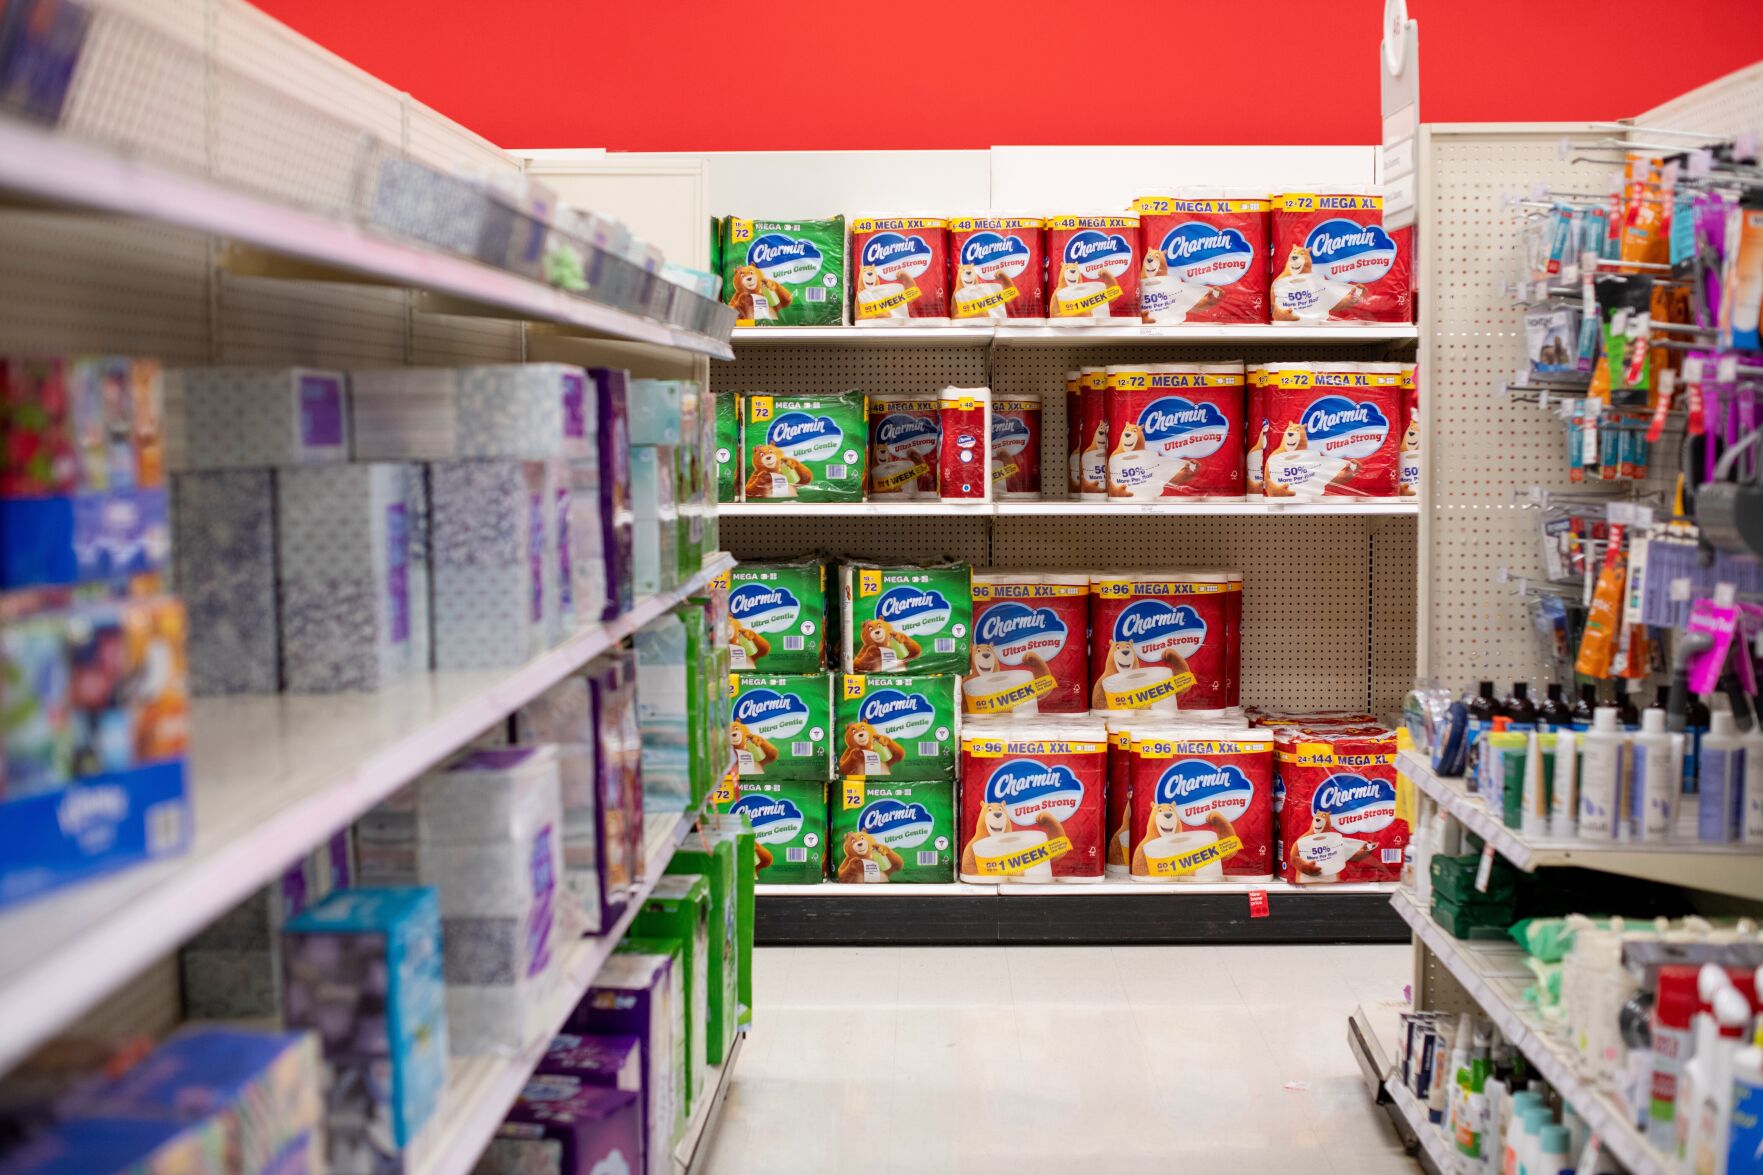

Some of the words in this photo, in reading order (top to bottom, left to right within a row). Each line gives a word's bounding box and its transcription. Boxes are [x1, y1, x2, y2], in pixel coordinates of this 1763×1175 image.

[1153, 201, 1169, 211] 72
[1175, 202, 1213, 213] MEGA
[1217, 202, 1233, 212] XL
[1298, 198, 1313, 208] 72
[1319, 198, 1357, 208] MEGA
[1361, 199, 1376, 208] XL
[755, 223, 782, 231] MEGA
[859, 222, 872, 230] 48
[875, 220, 904, 230] MEGA
[907, 220, 925, 228] XXL
[958, 221, 971, 229] 48
[974, 220, 1002, 229] MEGA
[1005, 219, 1023, 228] XXL
[1061, 219, 1075, 228] 48
[1078, 219, 1106, 228] MEGA
[1109, 219, 1127, 227] XXL
[736, 230, 749, 238] 72
[1312, 227, 1376, 257] Charmin
[752, 240, 806, 263] Charmin
[867, 238, 915, 262] Charmin
[966, 237, 1014, 261] Charmin
[1070, 236, 1118, 260] Charmin
[1167, 231, 1232, 260] Charmin
[773, 269, 792, 279] Ultra
[793, 264, 817, 273] Gentle
[882, 265, 901, 275] Ultra
[902, 259, 928, 268] Strong
[981, 264, 1000, 274] Ultra
[1000, 258, 1025, 268] Strong
[1085, 263, 1104, 273] Ultra
[1104, 257, 1129, 267] Strong
[1186, 266, 1212, 278] Ultra
[1212, 260, 1247, 271] Strong
[1331, 263, 1355, 275] Ultra
[1355, 257, 1390, 269] Strong
[879, 294, 906, 310] WEEK
[976, 293, 1004, 309] WEEK
[1080, 292, 1108, 309] WEEK
[1144, 292, 1168, 304] 50%
[1288, 290, 1312, 302] 50%
[1130, 376, 1144, 386] 72
[1151, 376, 1188, 386] MEGA
[1193, 376, 1207, 386] XL
[1294, 375, 1308, 385] 72
[1315, 376, 1350, 386] MEGA
[1355, 376, 1369, 385] XL
[755, 409, 769, 417] 72
[888, 401, 913, 410] MEGA
[916, 400, 933, 409] XXL
[1144, 404, 1207, 434] Charmin
[1307, 404, 1368, 433] Charmin
[773, 418, 826, 442] Charmin
[880, 418, 925, 442] Charmin
[793, 447, 812, 456] Ultra
[814, 442, 837, 451] Gentle
[894, 442, 912, 453] Ultra
[912, 438, 935, 448] Strong
[1002, 440, 1025, 448] Strong
[1164, 439, 1188, 451] Ultra
[1189, 433, 1222, 446] Strong
[1326, 440, 1349, 451] Ultra
[1351, 434, 1382, 445] Strong
[892, 470, 916, 484] WEEK
[1121, 466, 1145, 480] 50%
[1284, 466, 1307, 477] 50%
[713, 580, 726, 589] 72
[864, 583, 878, 591] 72
[973, 586, 989, 597] 96
[994, 586, 1029, 597] MEGA
[1034, 586, 1056, 596] XXL
[1112, 583, 1129, 594] 96
[1134, 584, 1170, 595] MEGA
[1174, 584, 1196, 594] XXL
[730, 590, 782, 614] Charmin
[881, 592, 933, 617] Charmin
[750, 619, 769, 629] Ultra
[771, 613, 794, 622] Gentle
[902, 622, 921, 631] Ultra
[922, 616, 945, 625] Gentle
[982, 611, 1045, 640] Charmin
[1122, 608, 1184, 638] Charmin
[1002, 645, 1027, 657] Ultra
[1027, 638, 1061, 649] Strong
[1142, 642, 1166, 654] Ultra
[1166, 635, 1200, 647] Strong
[741, 678, 767, 686] MEGA
[847, 686, 861, 694] 72
[996, 684, 1035, 706] WEEK
[1136, 682, 1175, 702] WEEK
[738, 695, 791, 719] Charmin
[865, 696, 917, 720] Charmin
[759, 724, 778, 733] Ultra
[779, 719, 803, 728] Gentle
[885, 725, 904, 733] Ultra
[905, 719, 929, 728] Gentle
[985, 743, 1002, 752] 96
[1007, 743, 1044, 753] MEGA
[1049, 743, 1072, 753] XXL
[1154, 743, 1171, 753] 96
[1176, 743, 1213, 754] MEGA
[1218, 743, 1241, 753] XXL
[1311, 754, 1333, 764] 144
[1338, 755, 1370, 765] MEGA
[1375, 755, 1389, 764] XL
[994, 768, 1060, 798] Charmin
[1164, 768, 1230, 799] Charmin
[716, 791, 730, 799] 72
[847, 796, 861, 804] 72
[1320, 781, 1380, 809] Charmin
[1015, 805, 1040, 817] Ultra
[1041, 799, 1076, 810] Strong
[1185, 805, 1210, 817] Ultra
[1212, 798, 1246, 809] Strong
[864, 805, 916, 829] Charmin
[1338, 815, 1362, 826] Ultra
[1363, 808, 1395, 819] Strong
[774, 825, 797, 834] Gentle
[884, 834, 903, 843] Ultra
[904, 828, 928, 837] Gentle
[1007, 846, 1048, 868] WEEK
[1178, 846, 1220, 869] WEEK
[1311, 845, 1331, 855] 50%
